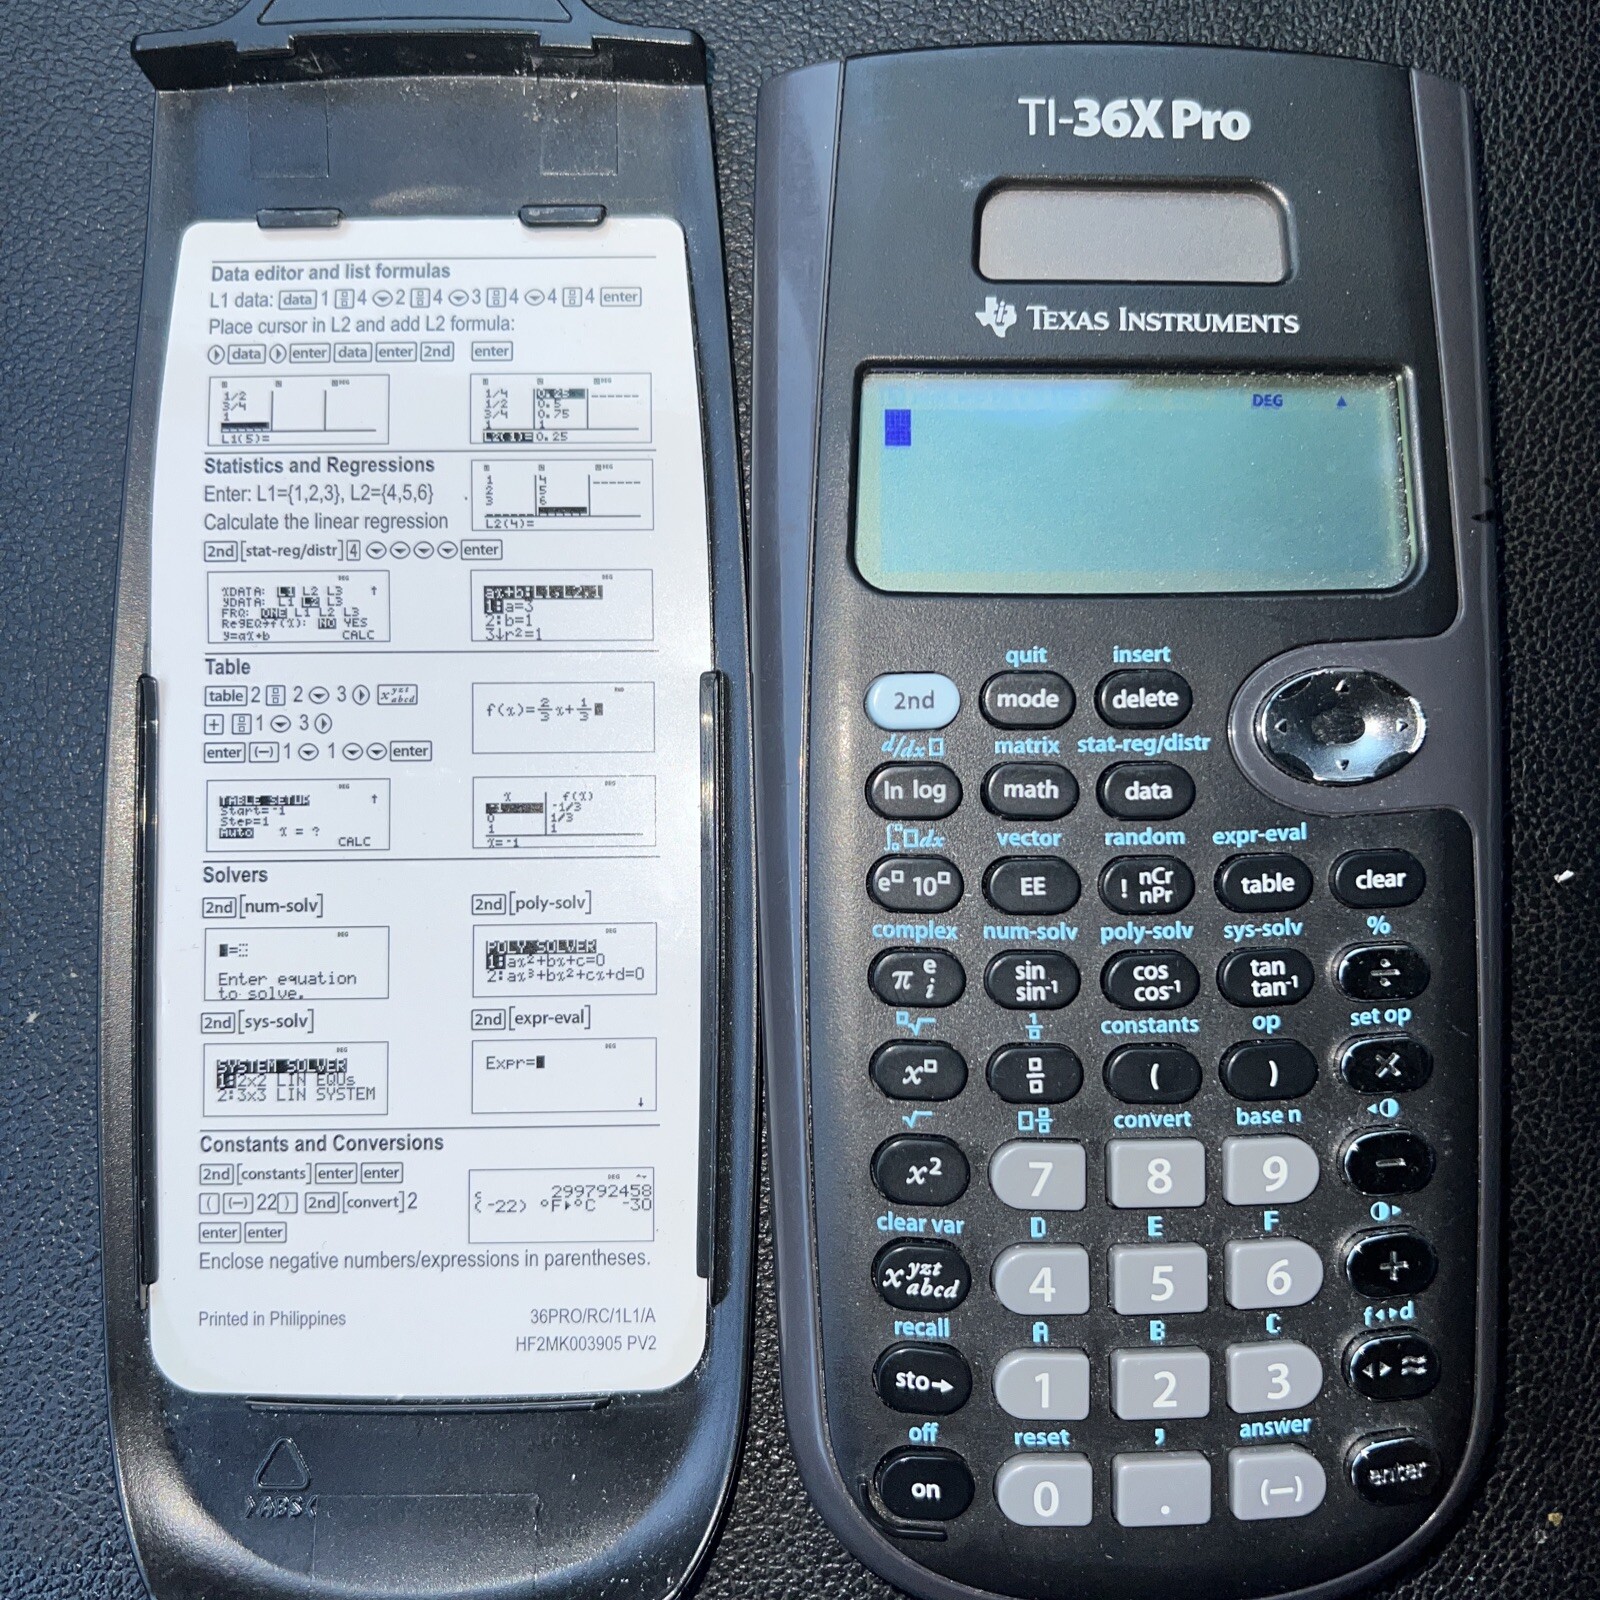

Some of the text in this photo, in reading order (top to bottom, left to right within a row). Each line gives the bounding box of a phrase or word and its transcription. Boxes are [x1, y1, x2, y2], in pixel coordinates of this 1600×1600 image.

[1018, 97, 1250, 141] TI-36X Pro
[212, 262, 450, 282] Data editor and list formulas
[210, 291, 312, 308] L1 data: data
[603, 292, 638, 302] enter
[209, 315, 516, 334] Place cursor in L2 and add L2 formula:
[1026, 305, 1300, 334] TEXAS INSTRUMENTS
[232, 345, 509, 360] data enter data enter 2nd enter
[1252, 394, 1283, 407] DEG
[204, 456, 435, 476] Statistics and Regressions
[204, 483, 434, 505] Enter: L1={1,2,3}, L2={4,5,6}
[204, 512, 448, 533] Calculate the linear regression
[207, 545, 234, 557] 2nd
[464, 544, 498, 556] enter
[343, 630, 375, 640] CALC
[1005, 646, 1048, 667] quit
[1113, 646, 1171, 663] insert
[205, 658, 250, 675] Table
[209, 690, 243, 701] table
[894, 691, 934, 710] 2nd
[997, 689, 1059, 708] mode
[1112, 688, 1179, 709] delete
[207, 746, 428, 758] enter enter
[995, 737, 1060, 754] matrix
[1077, 733, 1211, 754] stat-reg/distr
[913, 780, 947, 803] log
[1004, 780, 1059, 799] math
[1125, 781, 1173, 800] data
[338, 837, 371, 846] CALC
[997, 830, 1062, 846] vector
[1105, 828, 1186, 846] random
[1212, 822, 1307, 847] expr-eval
[203, 866, 268, 883] Solvers
[1139, 867, 1174, 885] nCr
[1241, 872, 1295, 894] table
[1355, 869, 1406, 889] clear
[1020, 876, 1046, 896] EE
[1139, 887, 1174, 904] nPr
[206, 902, 233, 914] 2nd
[475, 899, 502, 910] 2nd
[872, 922, 958, 943] complex
[983, 922, 1078, 940] num-solv
[1100, 921, 1194, 944] poly-solv
[1224, 918, 1303, 942] sys-solv
[1366, 915, 1391, 935] %
[1015, 961, 1045, 980] sin
[1133, 965, 1169, 980] cos
[1250, 959, 1285, 976] tan
[219, 971, 357, 986] Enter equation
[219, 987, 304, 1000] to solve.
[205, 1017, 231, 1029] 2nd
[475, 1014, 502, 1025] 2nd
[1101, 1017, 1200, 1034] constants
[1252, 1015, 1281, 1034] op
[1351, 1007, 1411, 1027] set op
[277, 1073, 307, 1087] LIN
[277, 1087, 376, 1101] LIN SYSTEM
[1114, 1112, 1192, 1129] convert
[1236, 1107, 1302, 1126] base n
[200, 1133, 444, 1153] Constants and Conversions
[203, 1168, 231, 1180] 2nd
[318, 1167, 354, 1178] enter
[364, 1167, 400, 1178] enter
[1028, 1162, 1053, 1197] 7
[1147, 1158, 1173, 1194] 8
[1263, 1156, 1288, 1192] 9
[551, 1184, 652, 1198] 299792458
[257, 1194, 277, 1211] 22
[308, 1196, 336, 1209] 2nd
[876, 1211, 965, 1234] clear var
[1031, 1216, 1047, 1238] D
[1148, 1216, 1164, 1237] E
[1264, 1210, 1279, 1231] F
[202, 1226, 283, 1238] enter enter
[200, 1249, 651, 1273] Enclose negative numbers/expressions in parentheses.
[1029, 1267, 1056, 1301] 4
[1151, 1265, 1174, 1301] 5
[1267, 1259, 1292, 1295] 6
[199, 1310, 346, 1329] Printed in Philippines
[531, 1308, 656, 1323] 36PRO/RC/1L1/A
[1266, 1313, 1281, 1333] C
[894, 1318, 950, 1338] recall
[1033, 1321, 1048, 1343] A
[1150, 1320, 1165, 1341] B
[517, 1335, 657, 1351] HF2MK003905 PV2
[1034, 1372, 1050, 1408] 1
[1152, 1371, 1177, 1408] 2
[1267, 1363, 1290, 1399] 3
[908, 1422, 939, 1442] off
[1240, 1417, 1313, 1438] answer
[1014, 1429, 1070, 1446] reset
[1369, 1461, 1427, 1487] enter
[911, 1482, 941, 1500] on
[1033, 1481, 1059, 1517] 0
